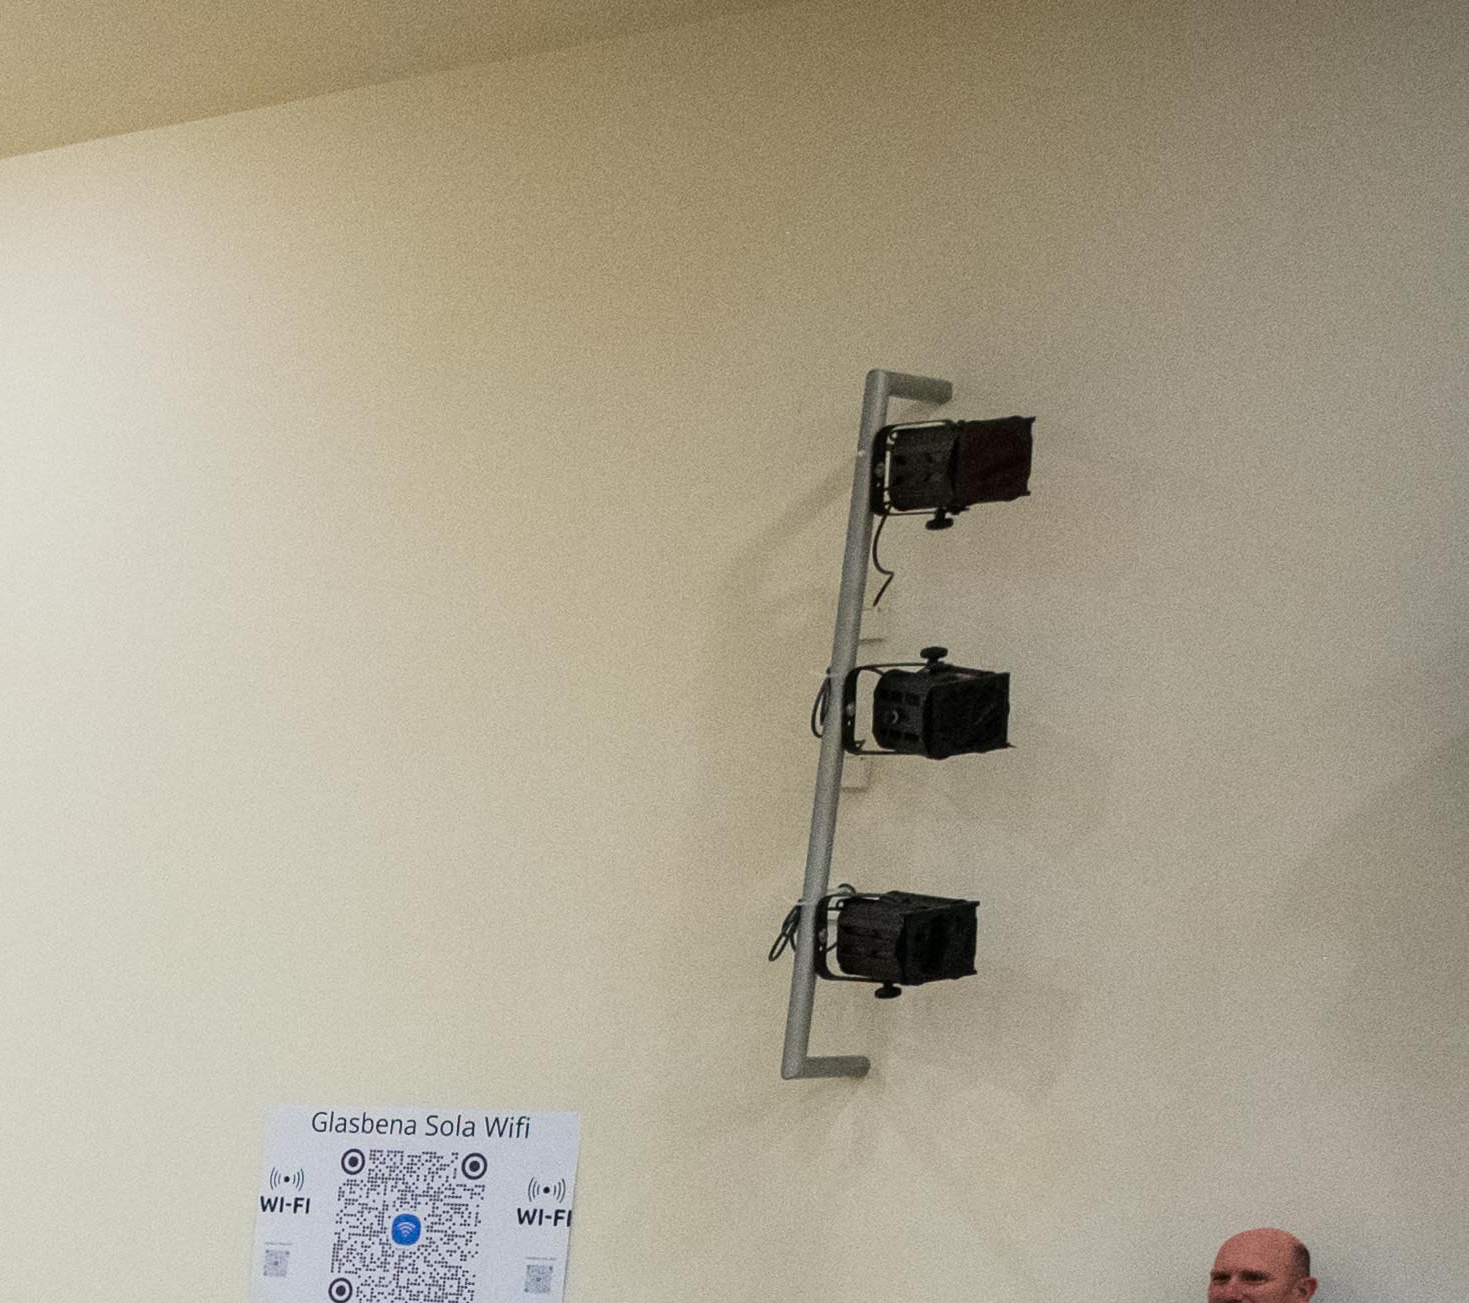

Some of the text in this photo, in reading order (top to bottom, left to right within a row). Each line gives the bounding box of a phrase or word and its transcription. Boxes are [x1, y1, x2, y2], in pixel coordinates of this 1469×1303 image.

[311, 1111, 531, 1139] Glasbena Sola Wifi
[259, 1196, 311, 1215] WI-FI
[516, 1207, 573, 1228] WI-FI
